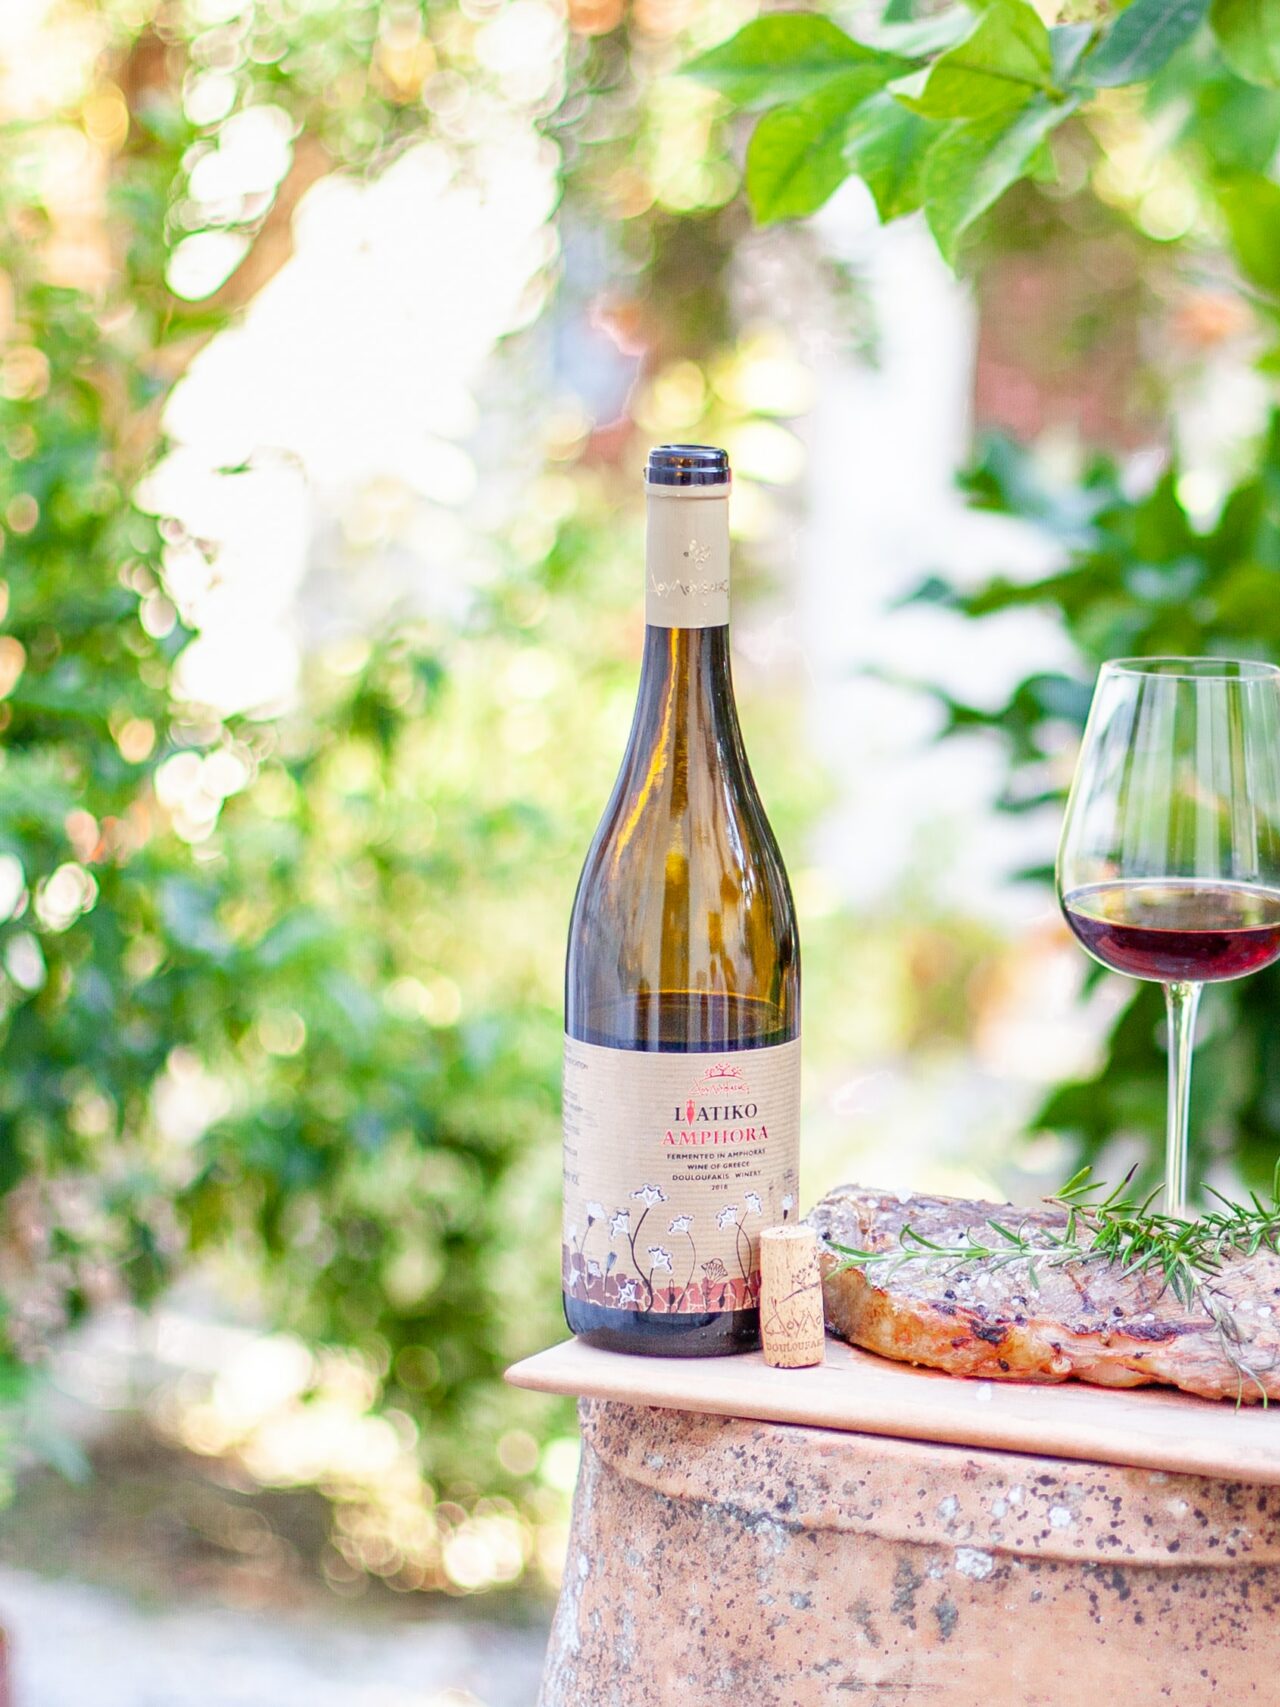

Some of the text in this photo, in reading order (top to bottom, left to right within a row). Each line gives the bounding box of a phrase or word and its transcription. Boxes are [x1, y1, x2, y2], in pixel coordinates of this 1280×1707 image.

[663, 1126, 768, 1145] AMPHORA
[727, 1149, 766, 1158] AMPHORAS
[723, 1161, 750, 1169] GREECE
[735, 1170, 762, 1178] WINERY
